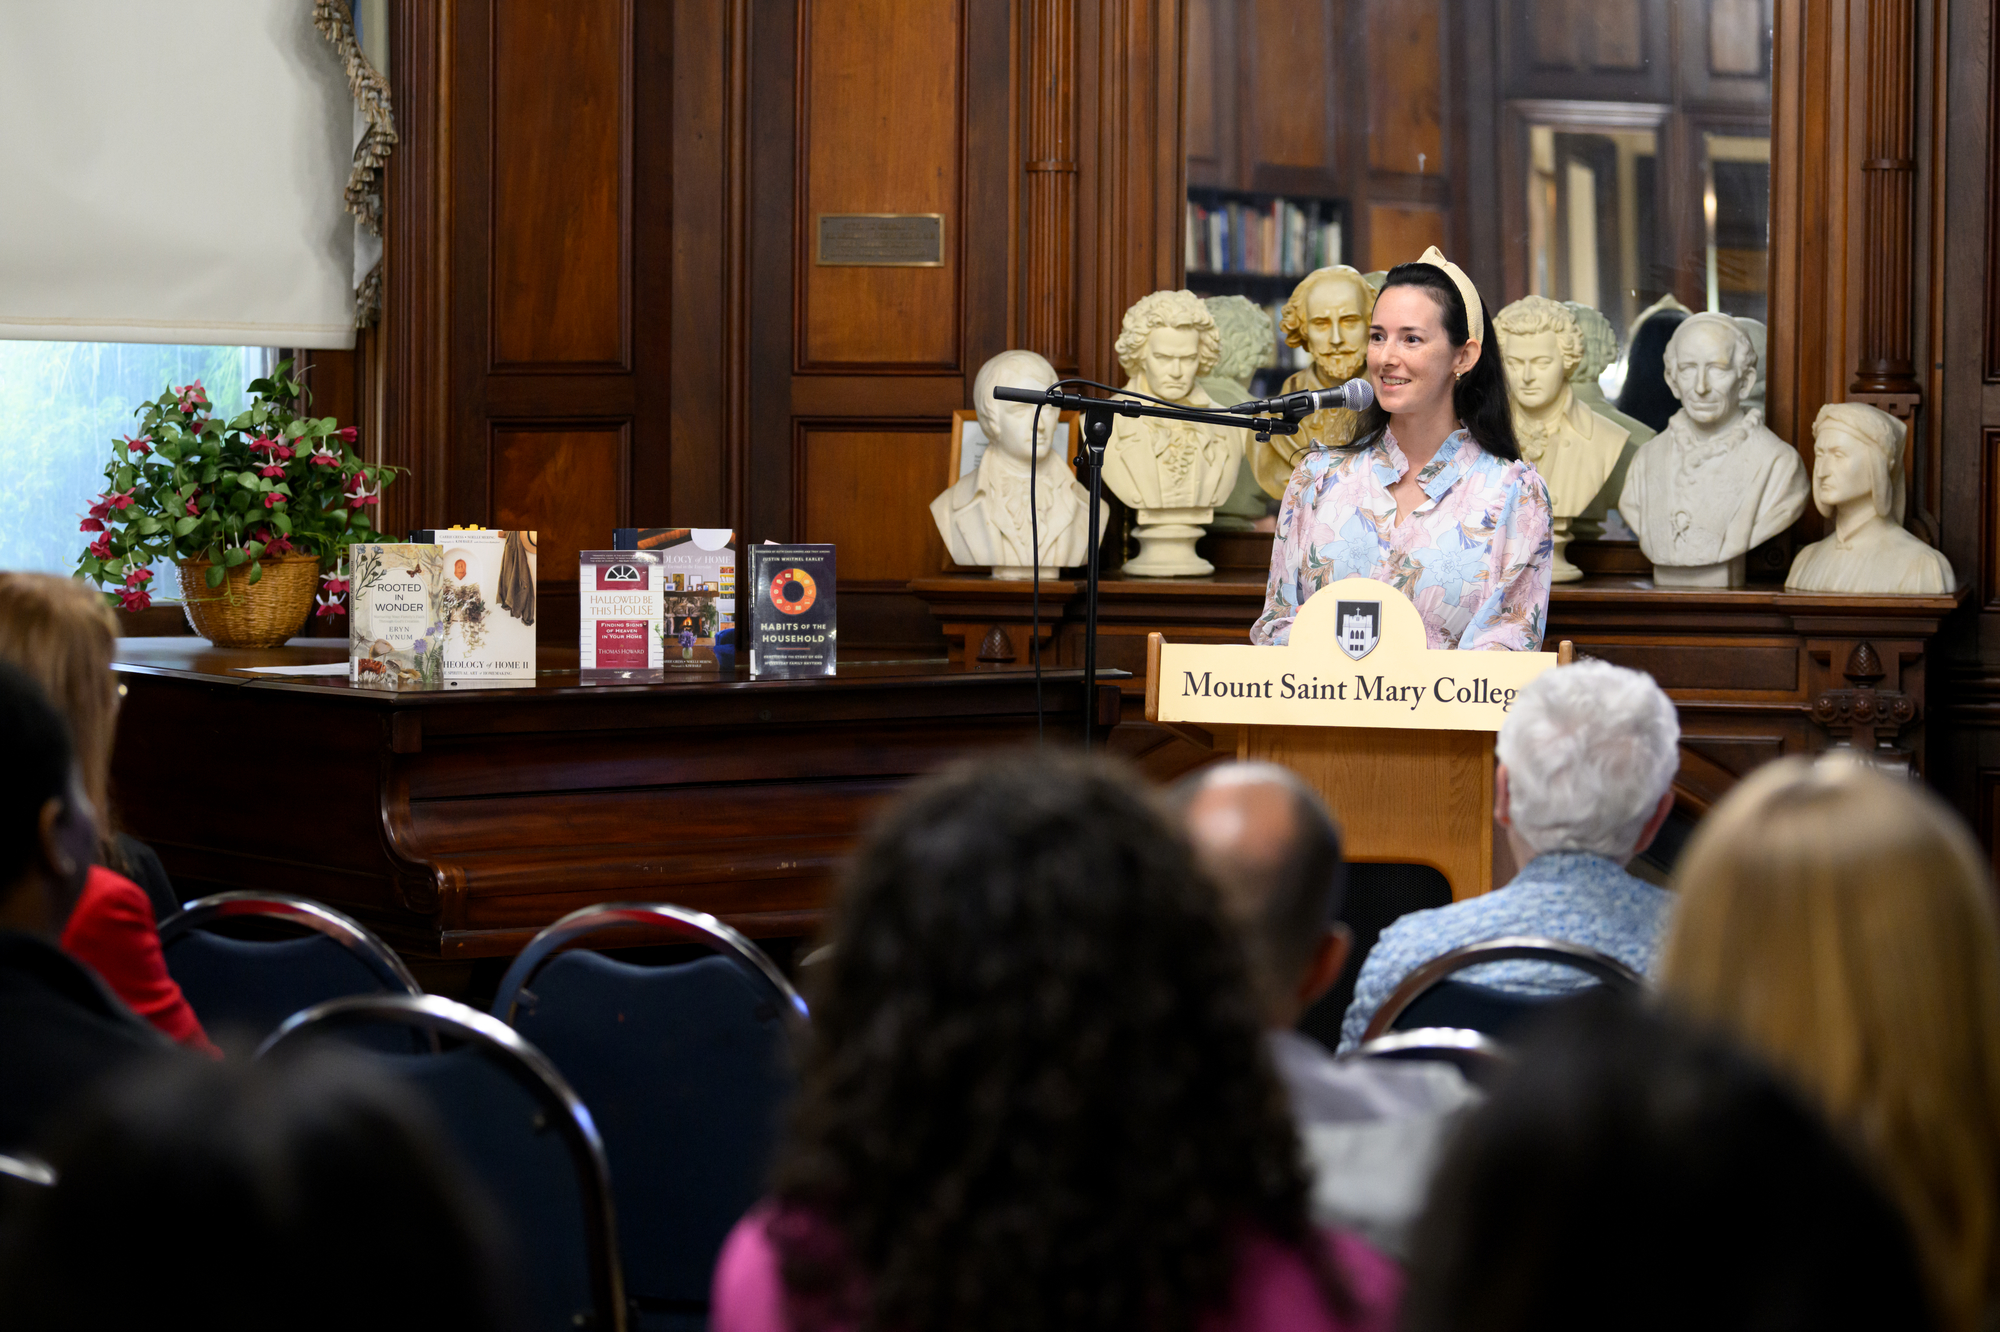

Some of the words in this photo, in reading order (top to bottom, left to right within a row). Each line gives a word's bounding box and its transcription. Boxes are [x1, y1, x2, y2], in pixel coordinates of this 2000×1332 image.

[663, 555, 693, 564] OLOGY
[704, 555, 731, 564] HOME
[377, 583, 422, 592] ROOTED
[590, 595, 641, 604] HALLOWED
[643, 596, 653, 604] BE
[375, 603, 424, 611] WONDER
[590, 606, 611, 615] THIS
[613, 605, 653, 615] HOUSE
[760, 623, 799, 631] HABITS
[443, 661, 484, 669] HEOLOGY
[486, 661, 492, 669] of
[495, 661, 520, 669] HOME
[523, 661, 529, 669] II
[1182, 671, 1273, 698] Mount
[1280, 673, 1347, 700] Saint
[1353, 675, 1426, 711] Mary
[1433, 676, 1519, 713] Colleg
